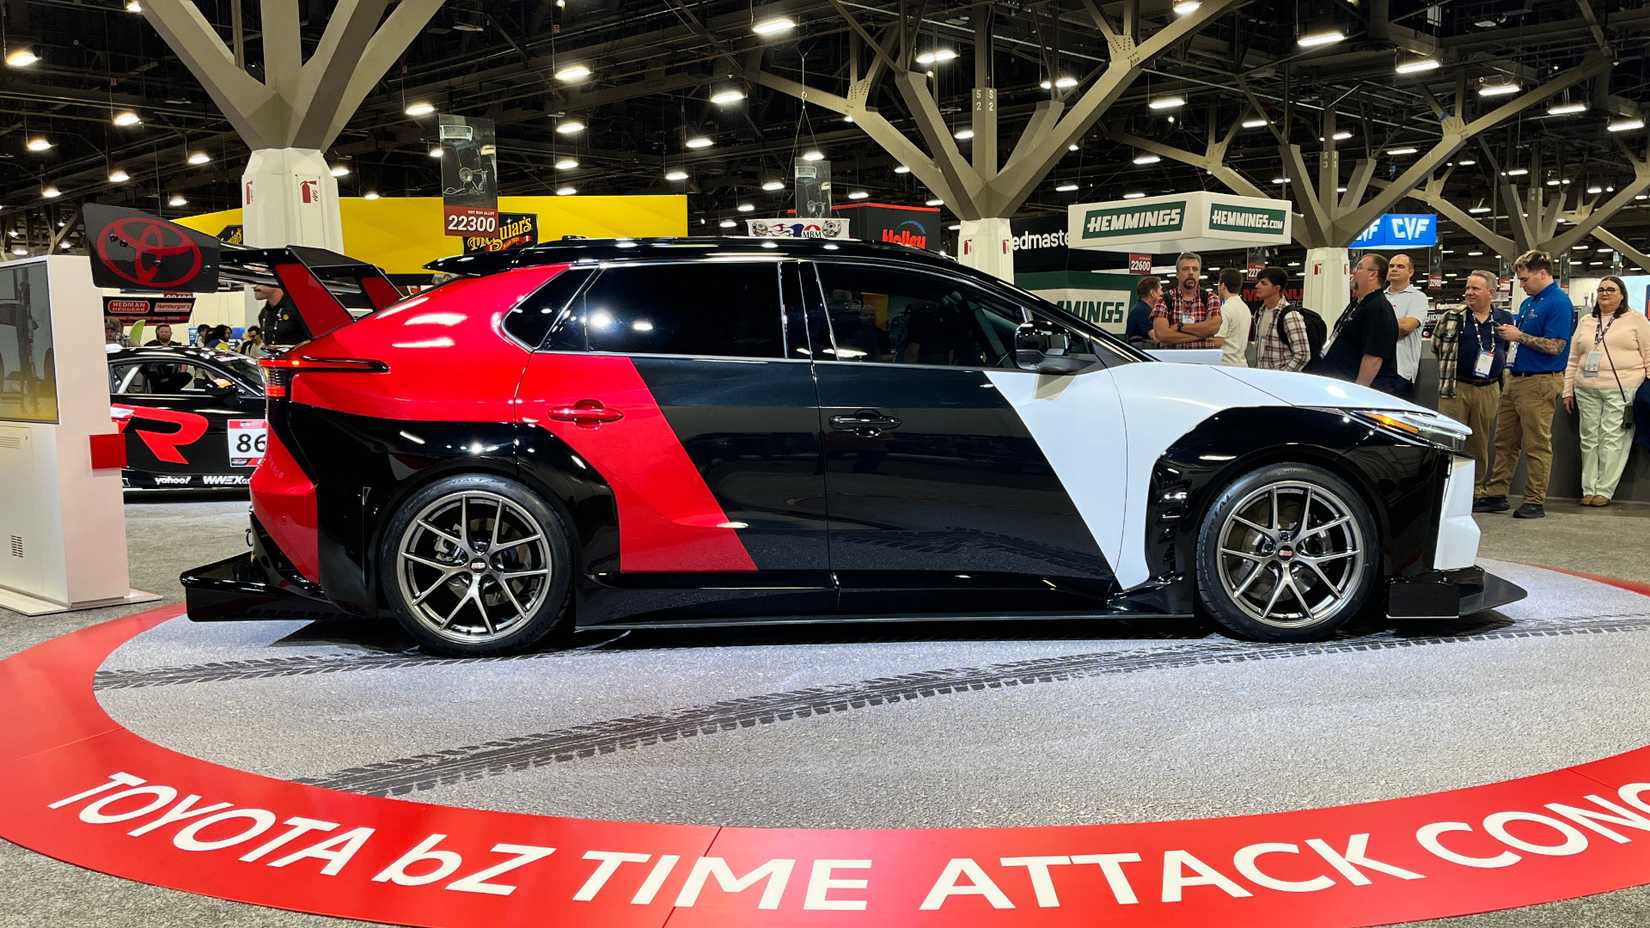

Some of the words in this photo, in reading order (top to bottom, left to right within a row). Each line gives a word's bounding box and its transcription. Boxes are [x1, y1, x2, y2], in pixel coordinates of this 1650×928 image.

[448, 215, 496, 232] 22300
[1087, 208, 1181, 233] HEMMINGS
[1392, 217, 1430, 240] CVF
[1131, 260, 1150, 271] 22600
[1056, 301, 1124, 323] MINGS
[236, 433, 267, 453] 86
[155, 475, 192, 485] yahoo!
[47, 771, 377, 878] TOYOTA
[371, 833, 558, 897] bZ
[572, 850, 873, 911] TIME
[919, 833, 1428, 911] ATTACK
